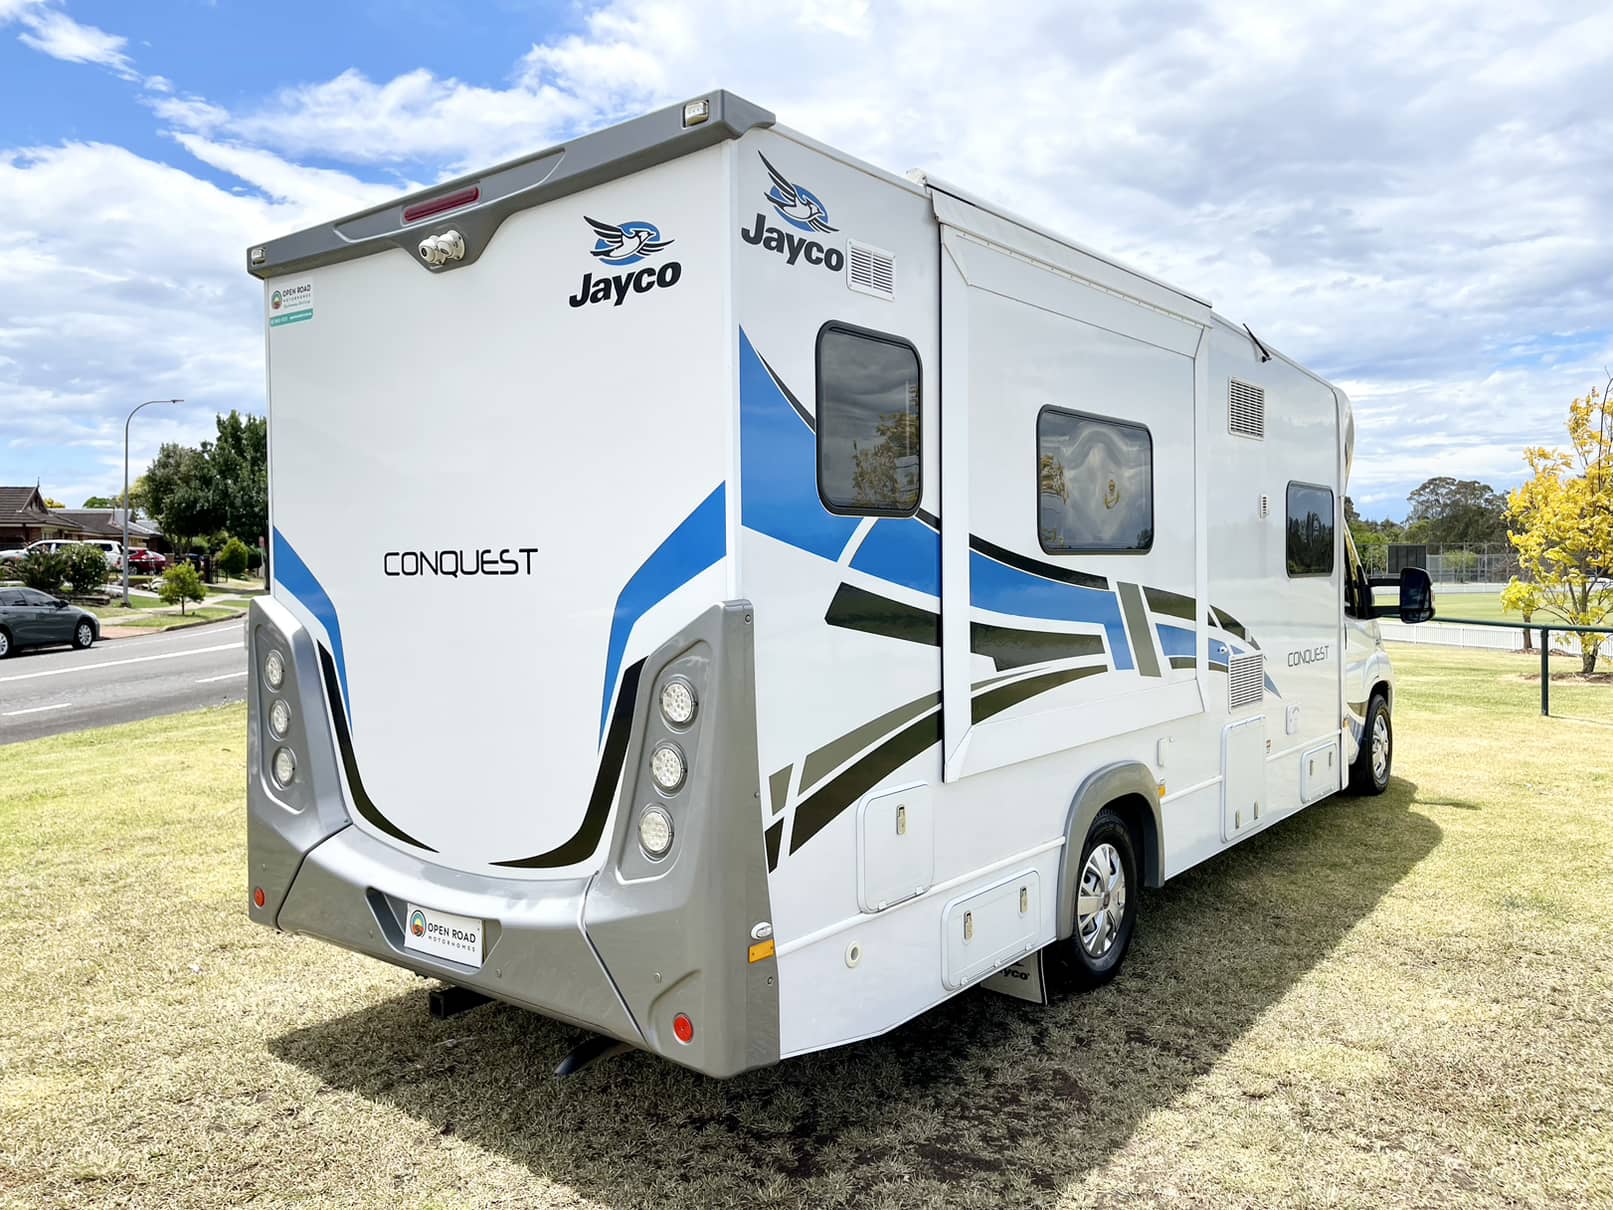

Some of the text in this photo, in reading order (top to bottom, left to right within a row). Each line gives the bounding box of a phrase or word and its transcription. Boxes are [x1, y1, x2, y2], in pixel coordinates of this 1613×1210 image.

[741, 213, 844, 272] Jayco
[569, 261, 682, 308] Jayco
[384, 548, 538, 578] CONQUEST
[1287, 645, 1328, 667] CONQUEST
[428, 922, 476, 943] OPEN ROAD
[428, 935, 476, 953] MOTORHOMES
